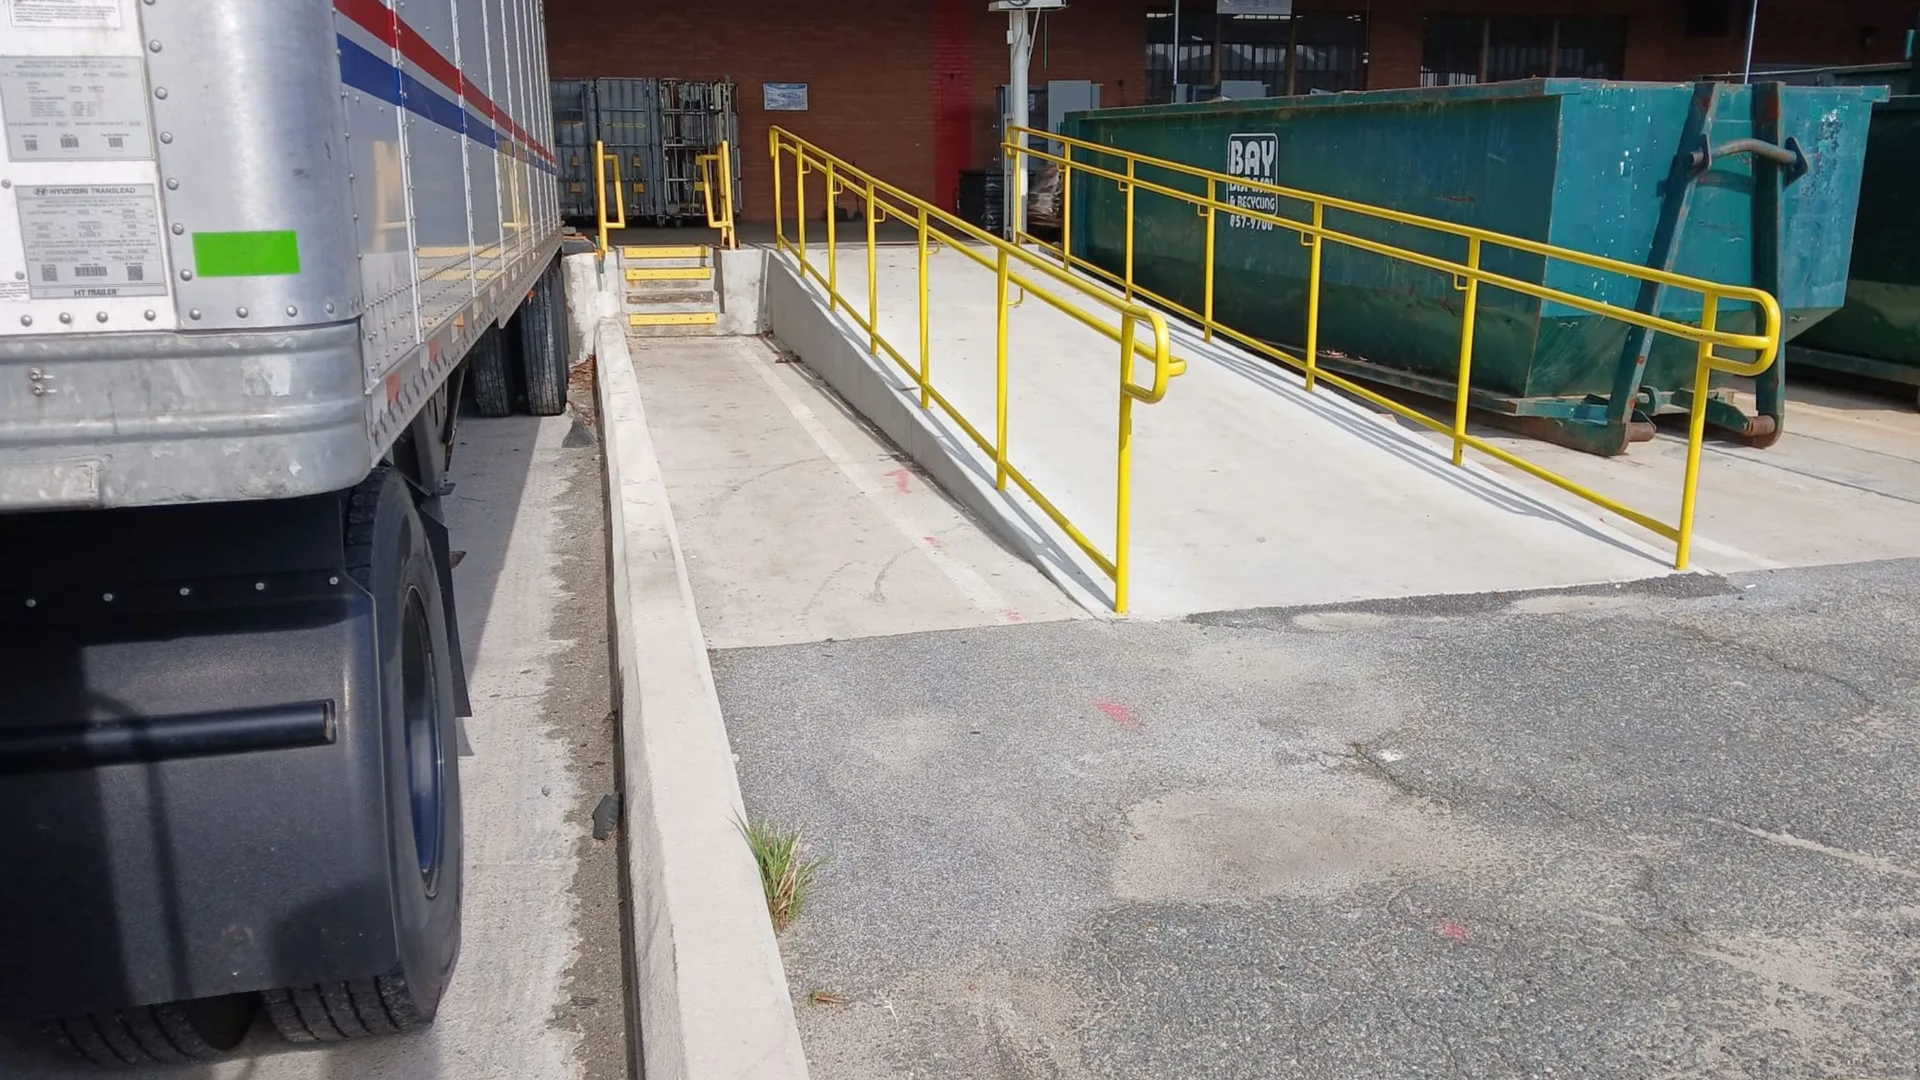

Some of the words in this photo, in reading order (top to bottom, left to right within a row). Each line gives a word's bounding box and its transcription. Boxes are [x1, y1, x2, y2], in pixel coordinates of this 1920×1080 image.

[1230, 140, 1275, 176] BAY
[50, 188, 88, 196] HYUNDAI
[91, 187, 136, 195] TRANSLEAD
[87, 288, 117, 296] TRAILER
